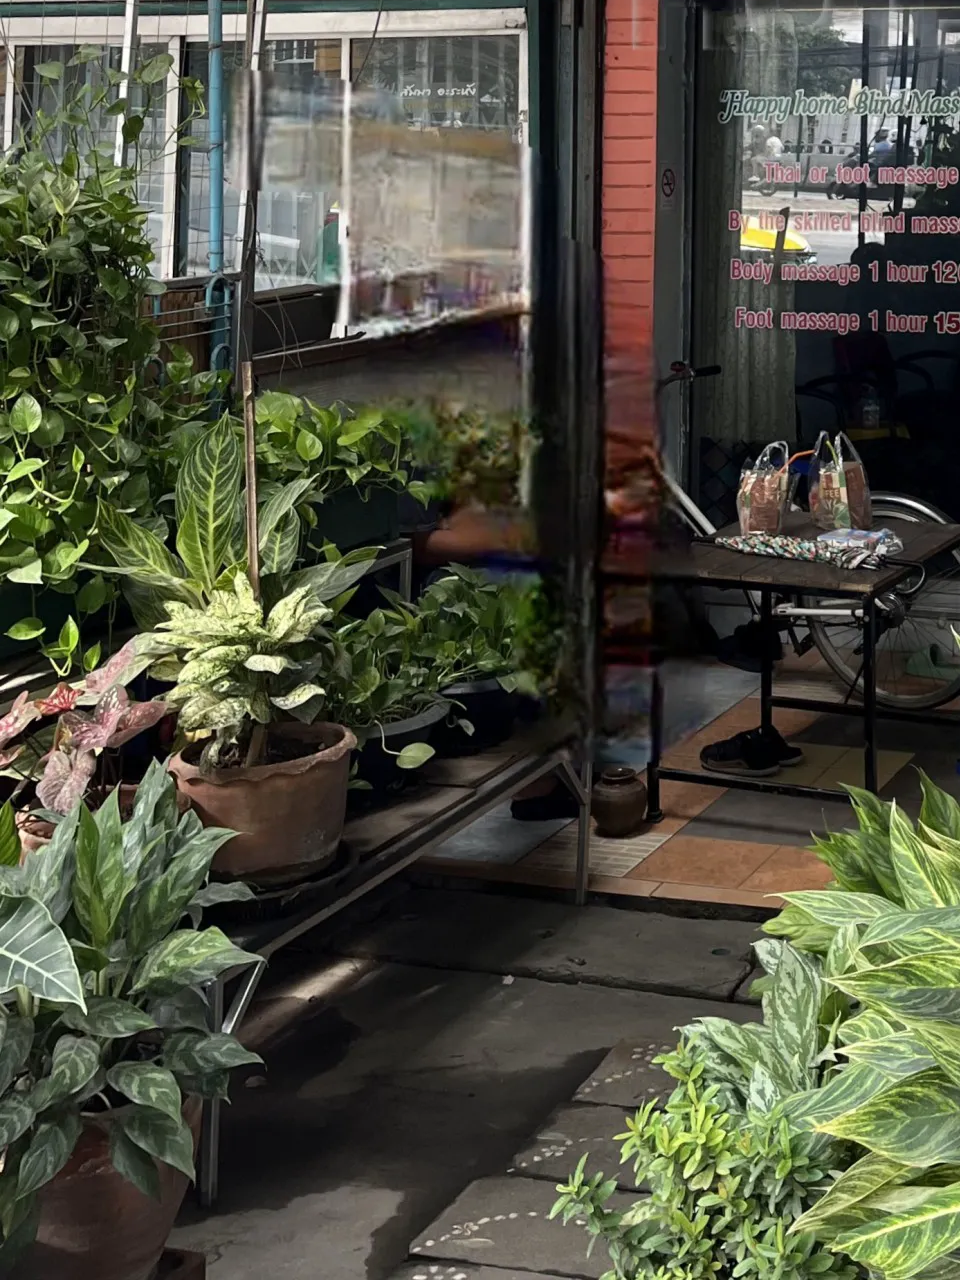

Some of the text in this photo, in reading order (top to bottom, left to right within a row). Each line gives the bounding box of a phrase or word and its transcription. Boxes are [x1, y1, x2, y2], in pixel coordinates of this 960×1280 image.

[794, 89, 849, 117] home
[853, 89, 905, 117] Blind
[763, 162, 959, 189] Thai or foot massage
[728, 210, 749, 234] By
[759, 210, 785, 231] the
[794, 210, 851, 232] skilled
[860, 210, 905, 233] blind
[730, 259, 774, 284] Body
[781, 262, 860, 286] massage
[868, 260, 879, 283] 1
[886, 261, 928, 283] hour
[734, 307, 774, 329] Foot
[780, 310, 860, 335] massage
[868, 309, 879, 332] 1
[886, 309, 928, 333] hour
